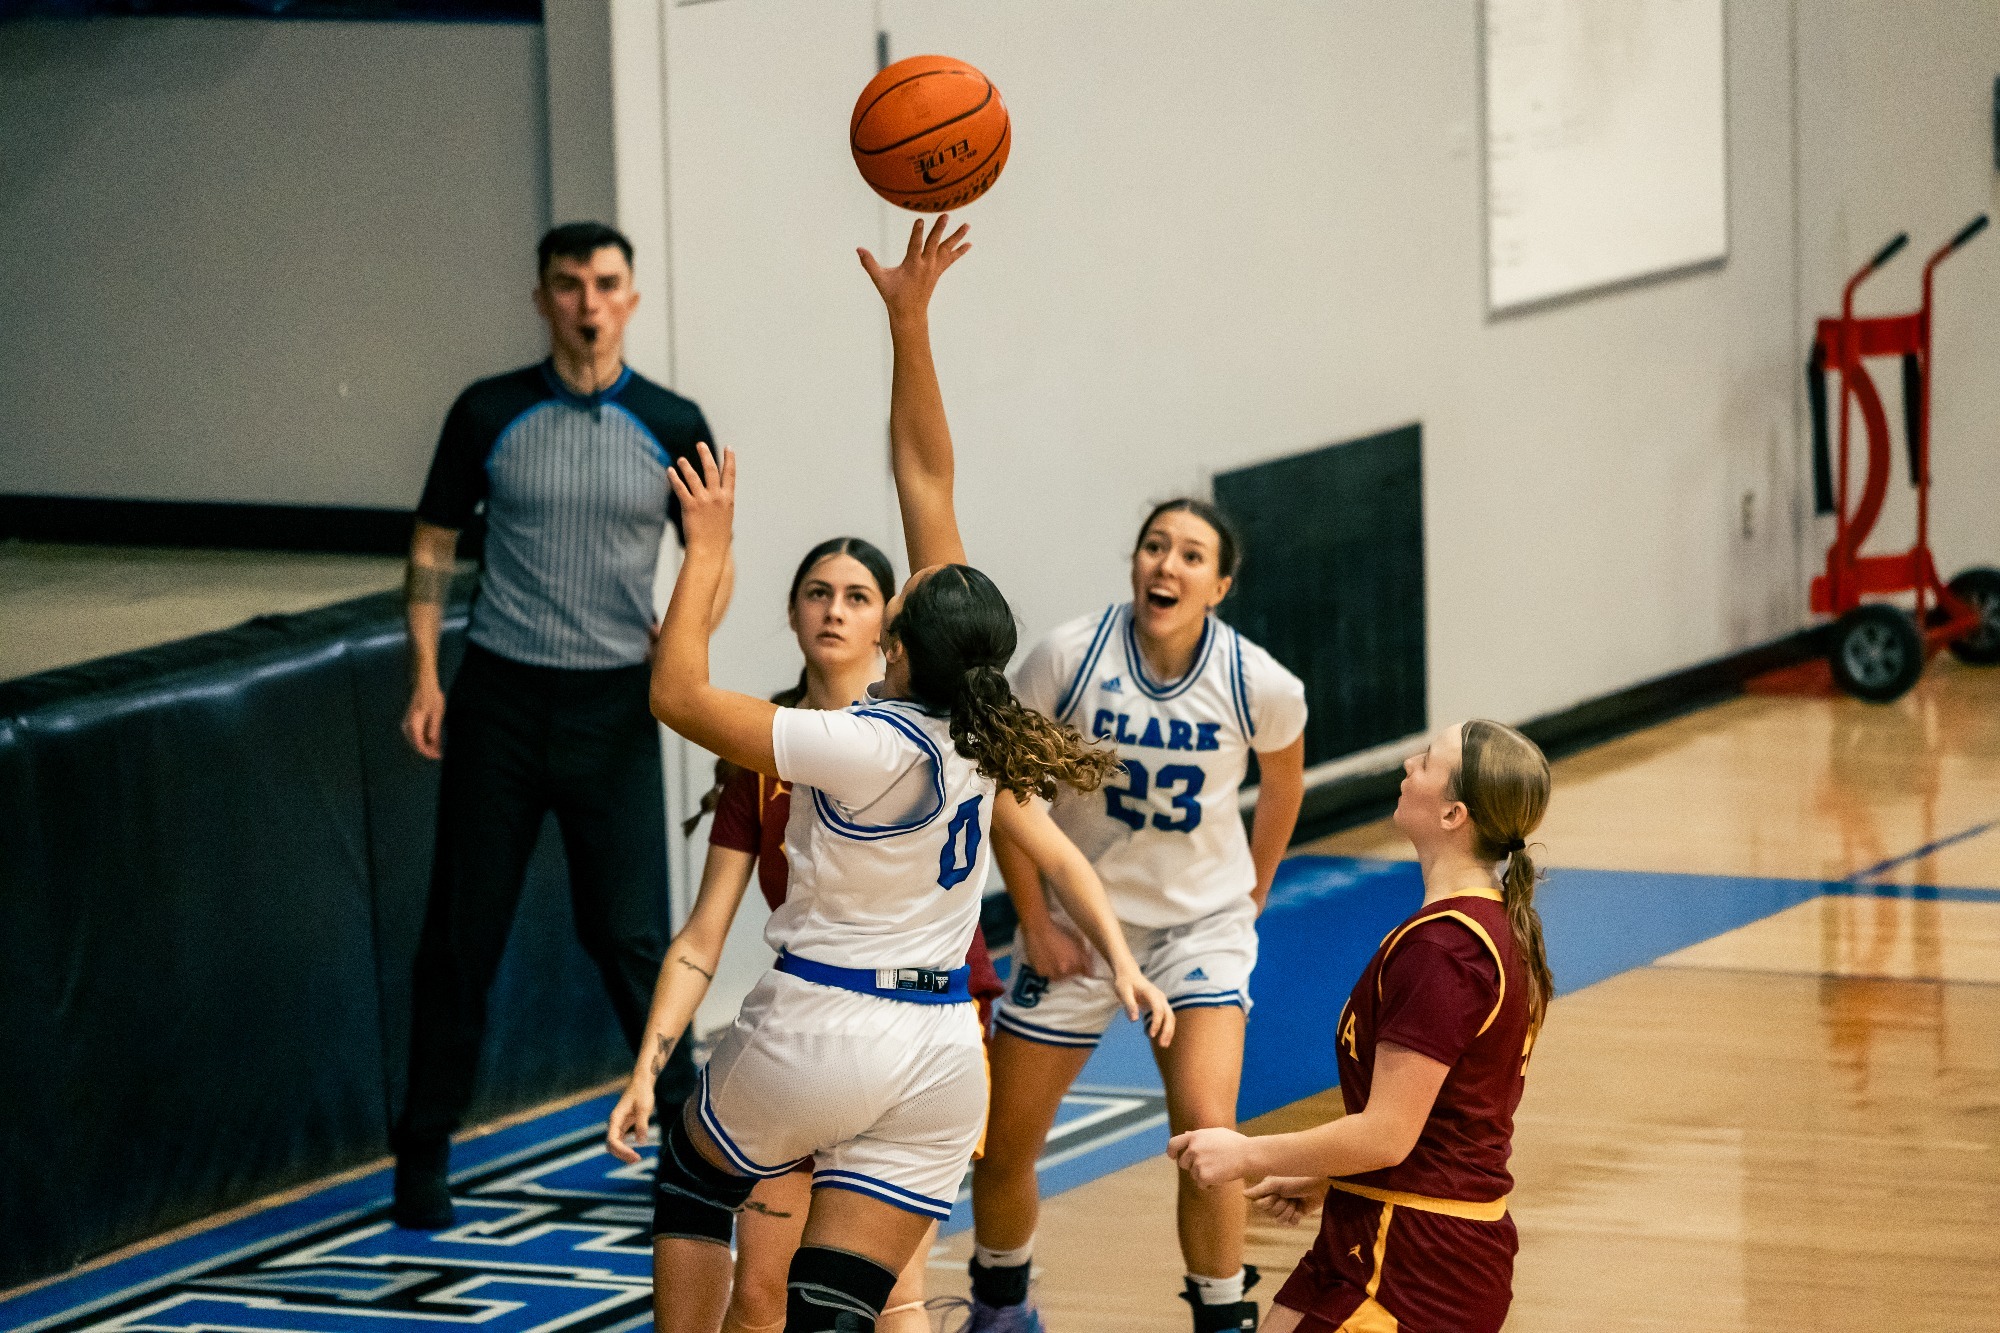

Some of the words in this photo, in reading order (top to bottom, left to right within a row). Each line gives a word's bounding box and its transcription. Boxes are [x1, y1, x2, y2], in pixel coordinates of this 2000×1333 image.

[1092, 708, 1221, 751] CLARK
[1103, 759, 1206, 834] 23
[936, 793, 984, 891] 0
[1337, 998, 1359, 1062] A
